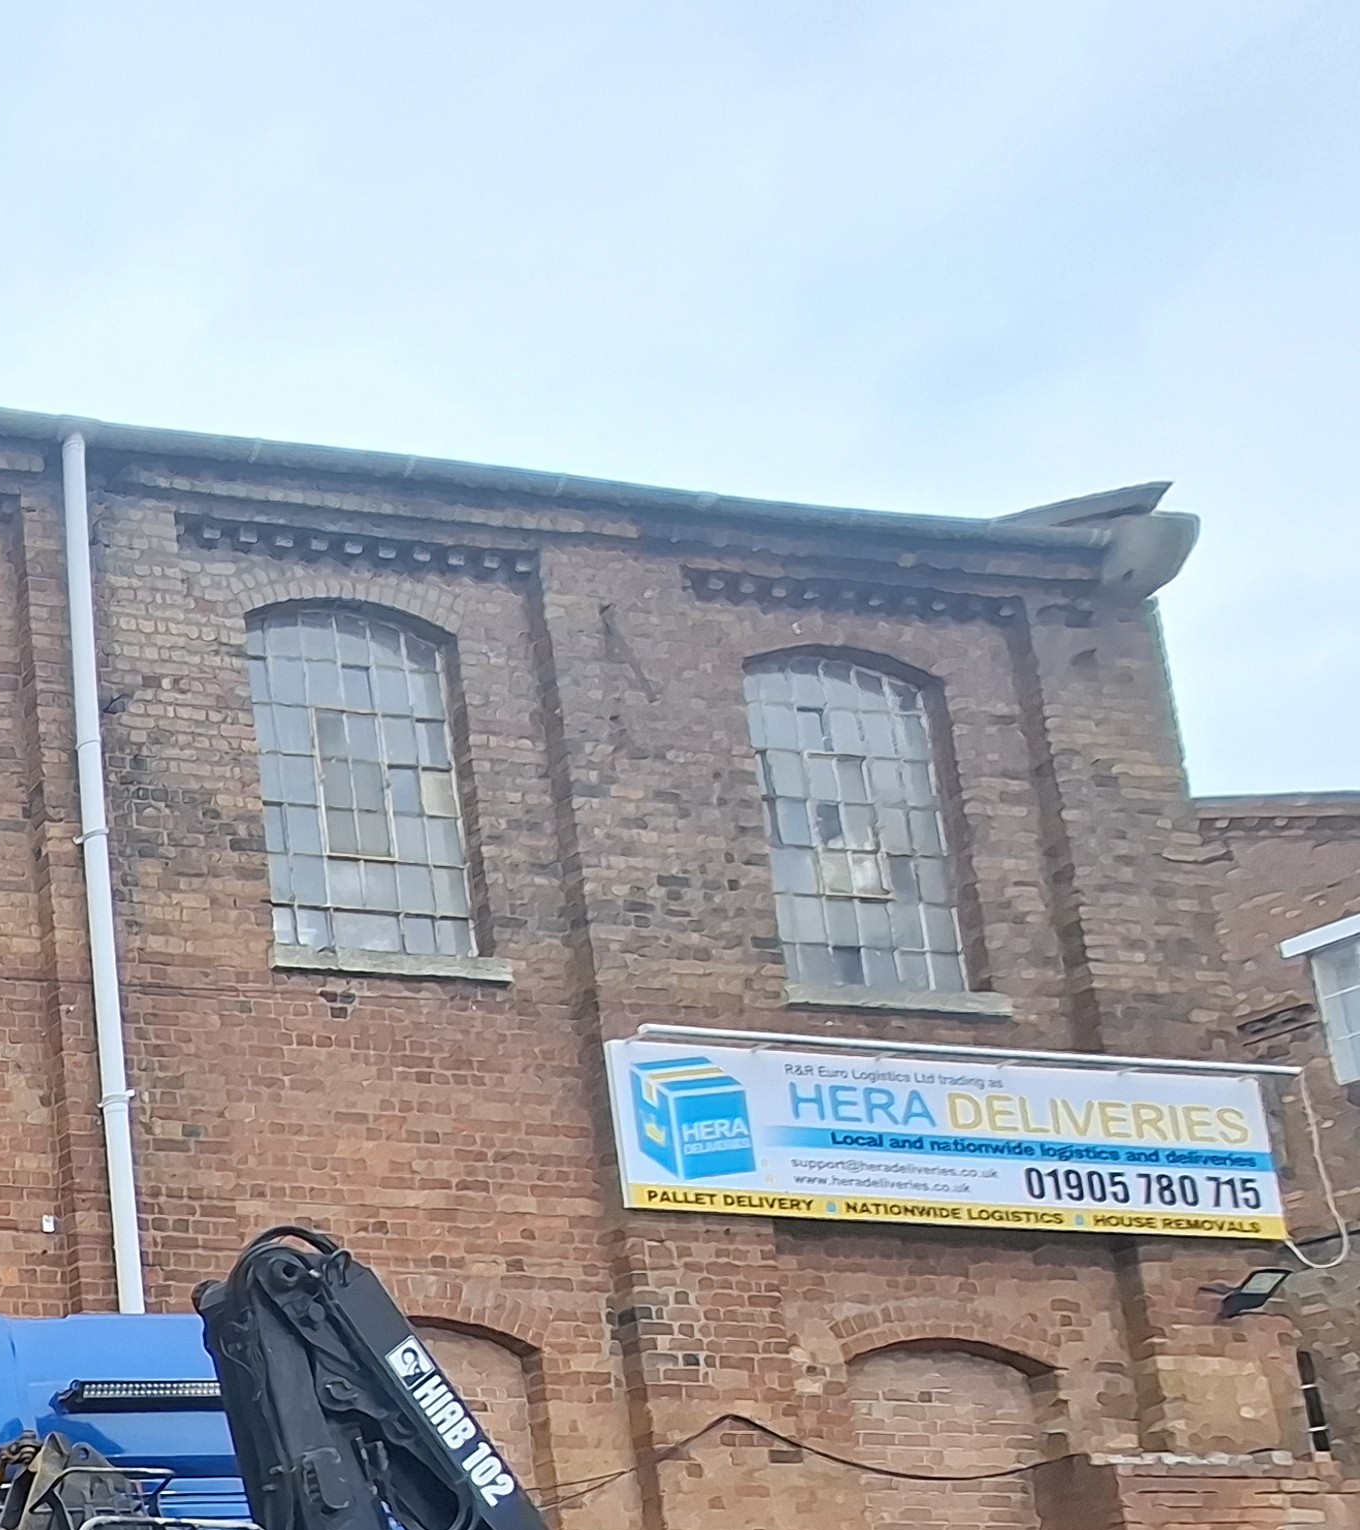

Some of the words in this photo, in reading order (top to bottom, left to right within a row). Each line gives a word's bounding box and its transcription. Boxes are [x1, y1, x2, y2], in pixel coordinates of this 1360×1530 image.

[818, 1066, 848, 1080] Euro
[852, 1068, 911, 1084] Logistics
[914, 1072, 935, 1084] Ltd
[938, 1074, 985, 1090] trading
[988, 1078, 1004, 1089] as
[681, 1116, 750, 1142] HERA
[789, 1082, 937, 1128] HERA
[947, 1091, 1250, 1146] DELIVERIES
[684, 1137, 752, 1156] DELIV
[831, 1131, 883, 1148] Local
[889, 1135, 923, 1150] and
[930, 1137, 1036, 1158] nationwide
[1040, 1143, 1120, 1162] logistics
[1126, 1149, 1160, 1164] and
[1166, 1149, 1258, 1168] deliveries
[793, 1174, 972, 1194] www.heradeliveries.co.uk
[1025, 1167, 1130, 1204] 01905
[1137, 1173, 1199, 1207] 780
[1206, 1176, 1262, 1210] 715
[647, 1189, 717, 1205] PALLET
[723, 1194, 815, 1212] DELIVERY
[845, 1201, 962, 1219] NATIONWIDE
[967, 1206, 1065, 1225] LOGISTICS
[1093, 1213, 1157, 1229] HOUSE
[1161, 1217, 1261, 1234] REMOVALS
[412, 1374, 477, 1450] HIAB
[462, 1441, 515, 1508] 102
